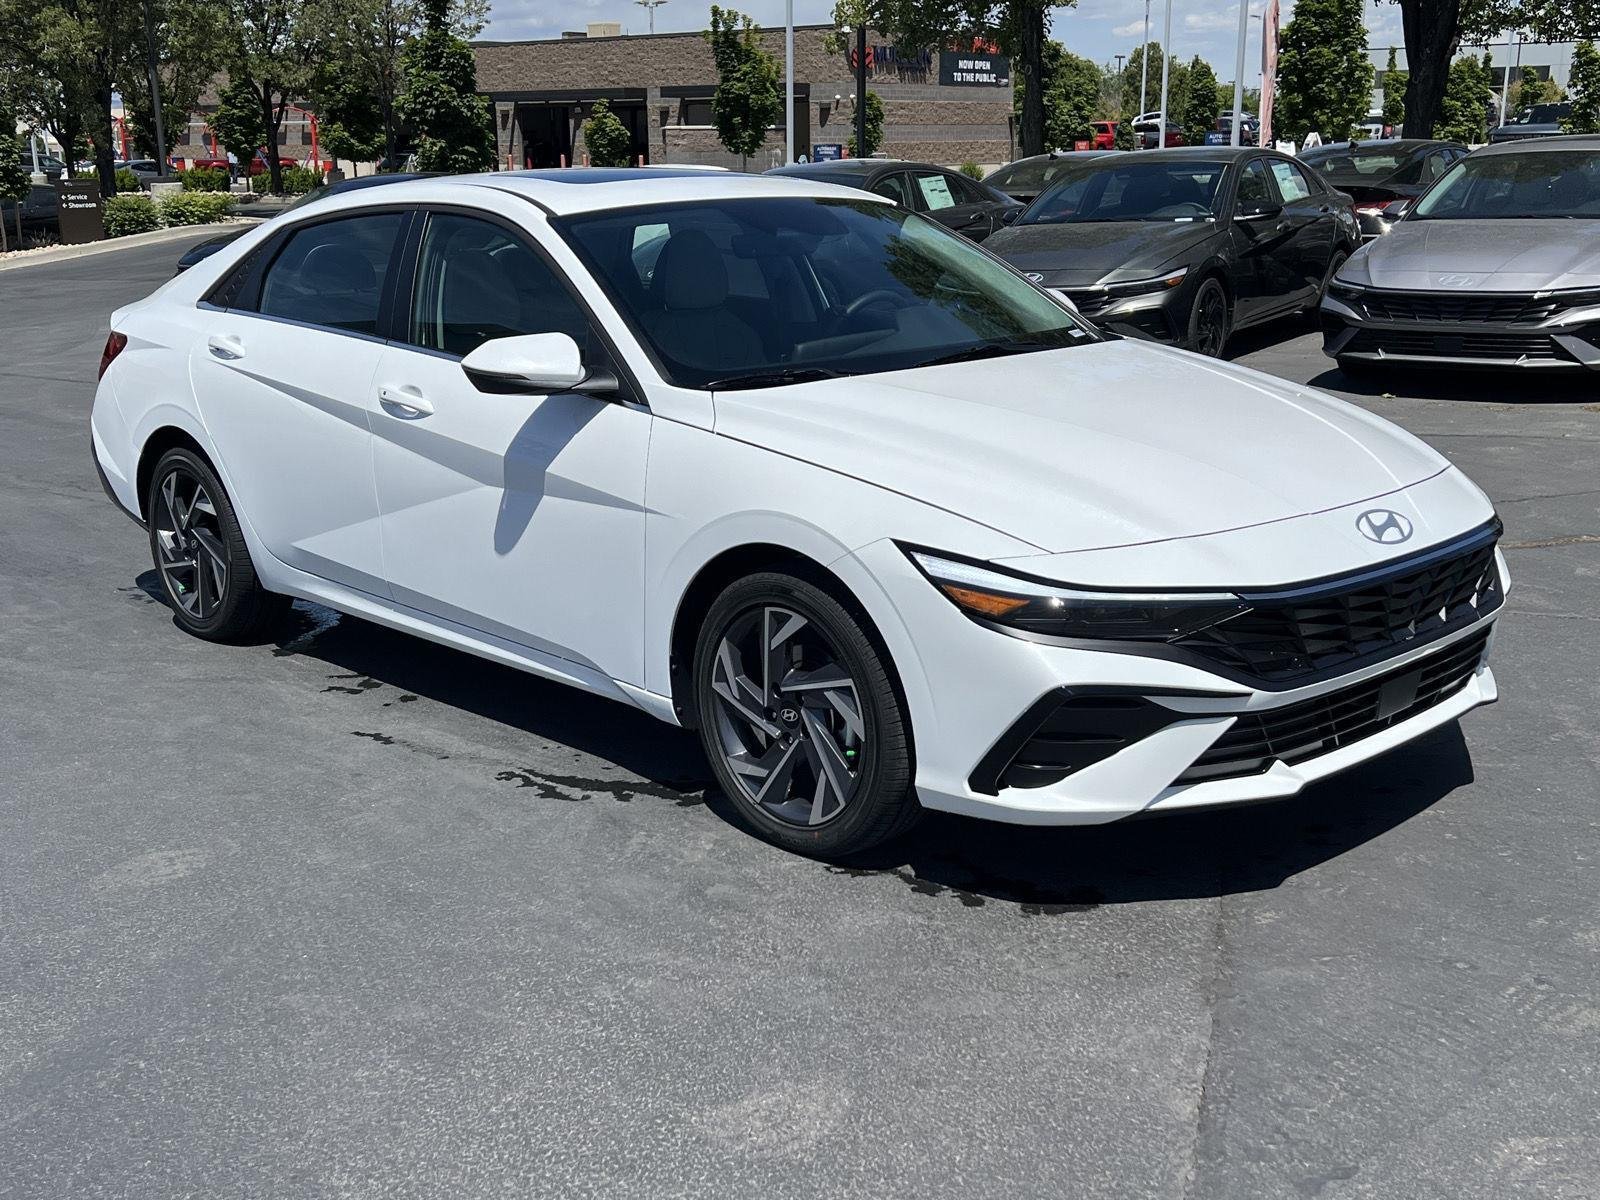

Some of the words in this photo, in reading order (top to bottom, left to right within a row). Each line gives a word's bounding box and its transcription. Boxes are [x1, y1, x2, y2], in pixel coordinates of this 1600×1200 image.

[958, 60, 974, 69] NOW
[974, 60, 991, 70] OPEN
[953, 72, 962, 82] TO
[962, 72, 975, 82] THE
[975, 72, 997, 83] PUBLIC
